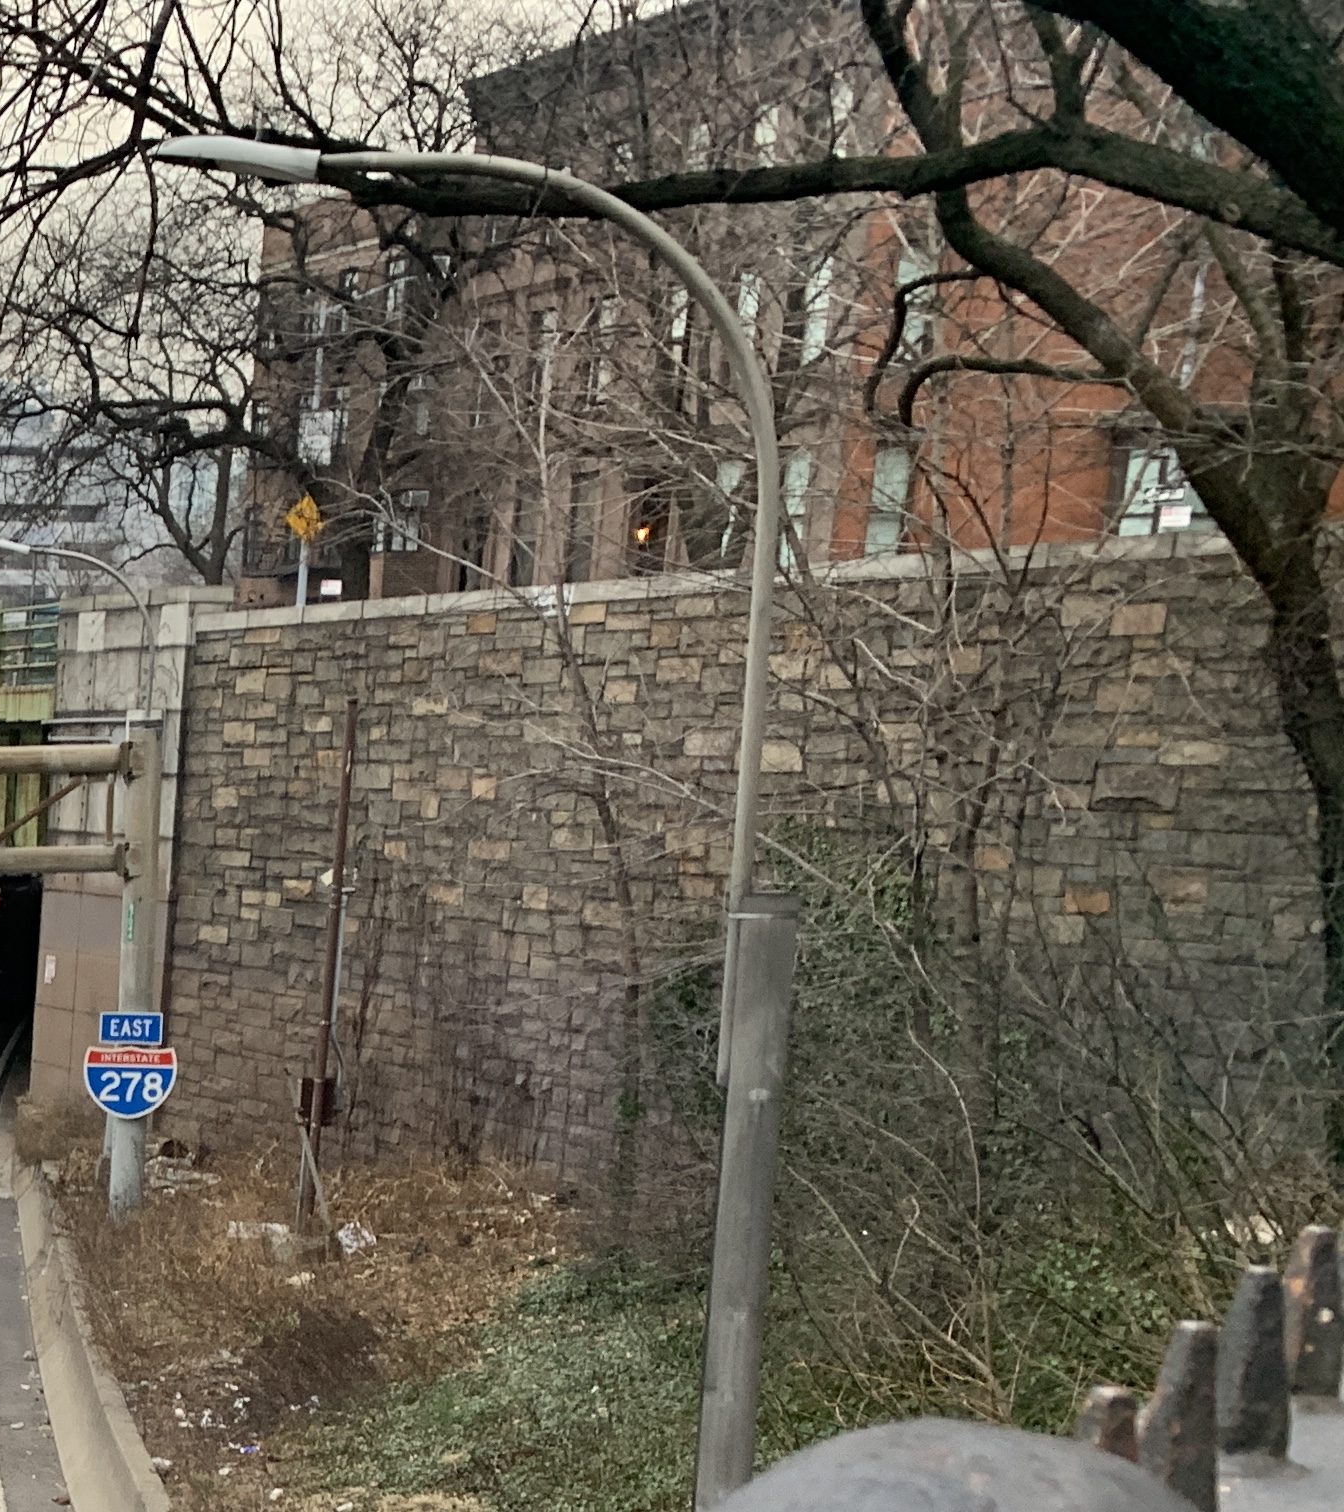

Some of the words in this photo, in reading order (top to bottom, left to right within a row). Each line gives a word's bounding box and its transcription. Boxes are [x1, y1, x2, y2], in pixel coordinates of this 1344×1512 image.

[110, 1019, 153, 1037] EAST
[100, 1053, 161, 1063] INTERSTATE
[99, 1071, 163, 1103] 278
